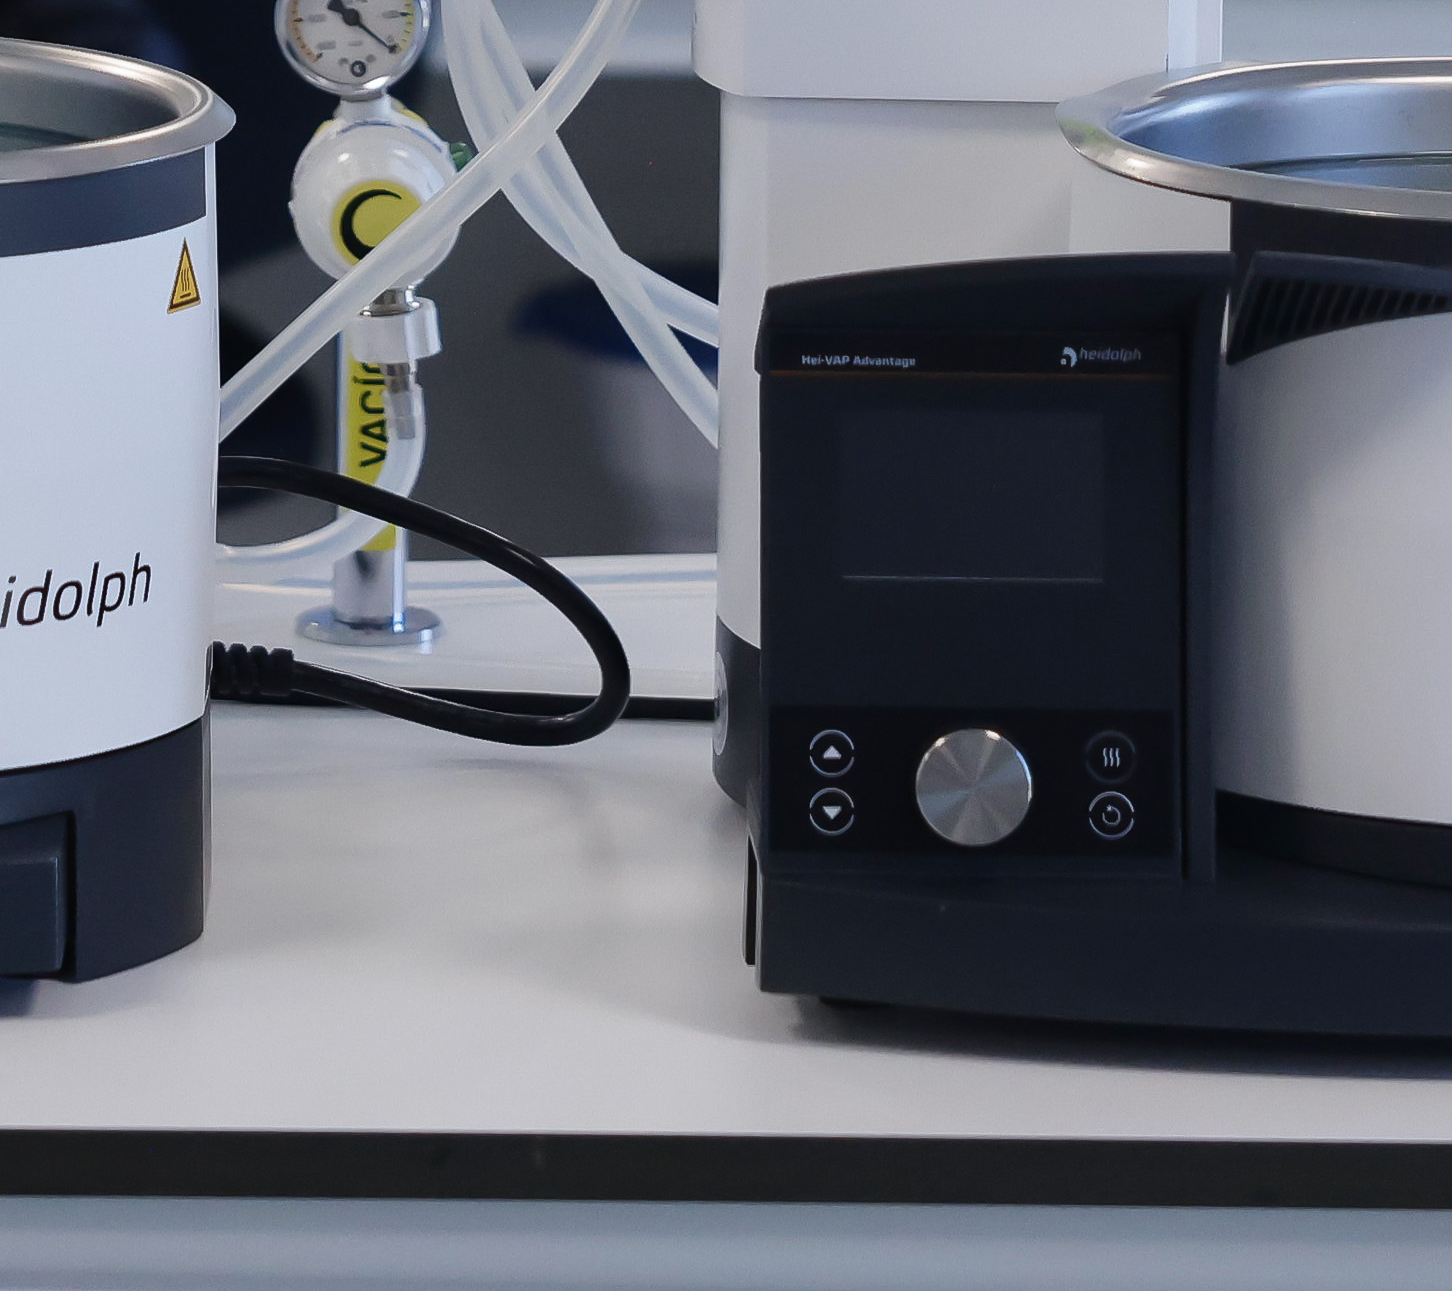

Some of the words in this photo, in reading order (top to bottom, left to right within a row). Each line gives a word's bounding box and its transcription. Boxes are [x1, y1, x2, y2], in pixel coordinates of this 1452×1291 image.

[801, 354, 850, 366] Hei-VAP
[853, 355, 916, 369] Advantage
[1080, 347, 1142, 362] heidolph
